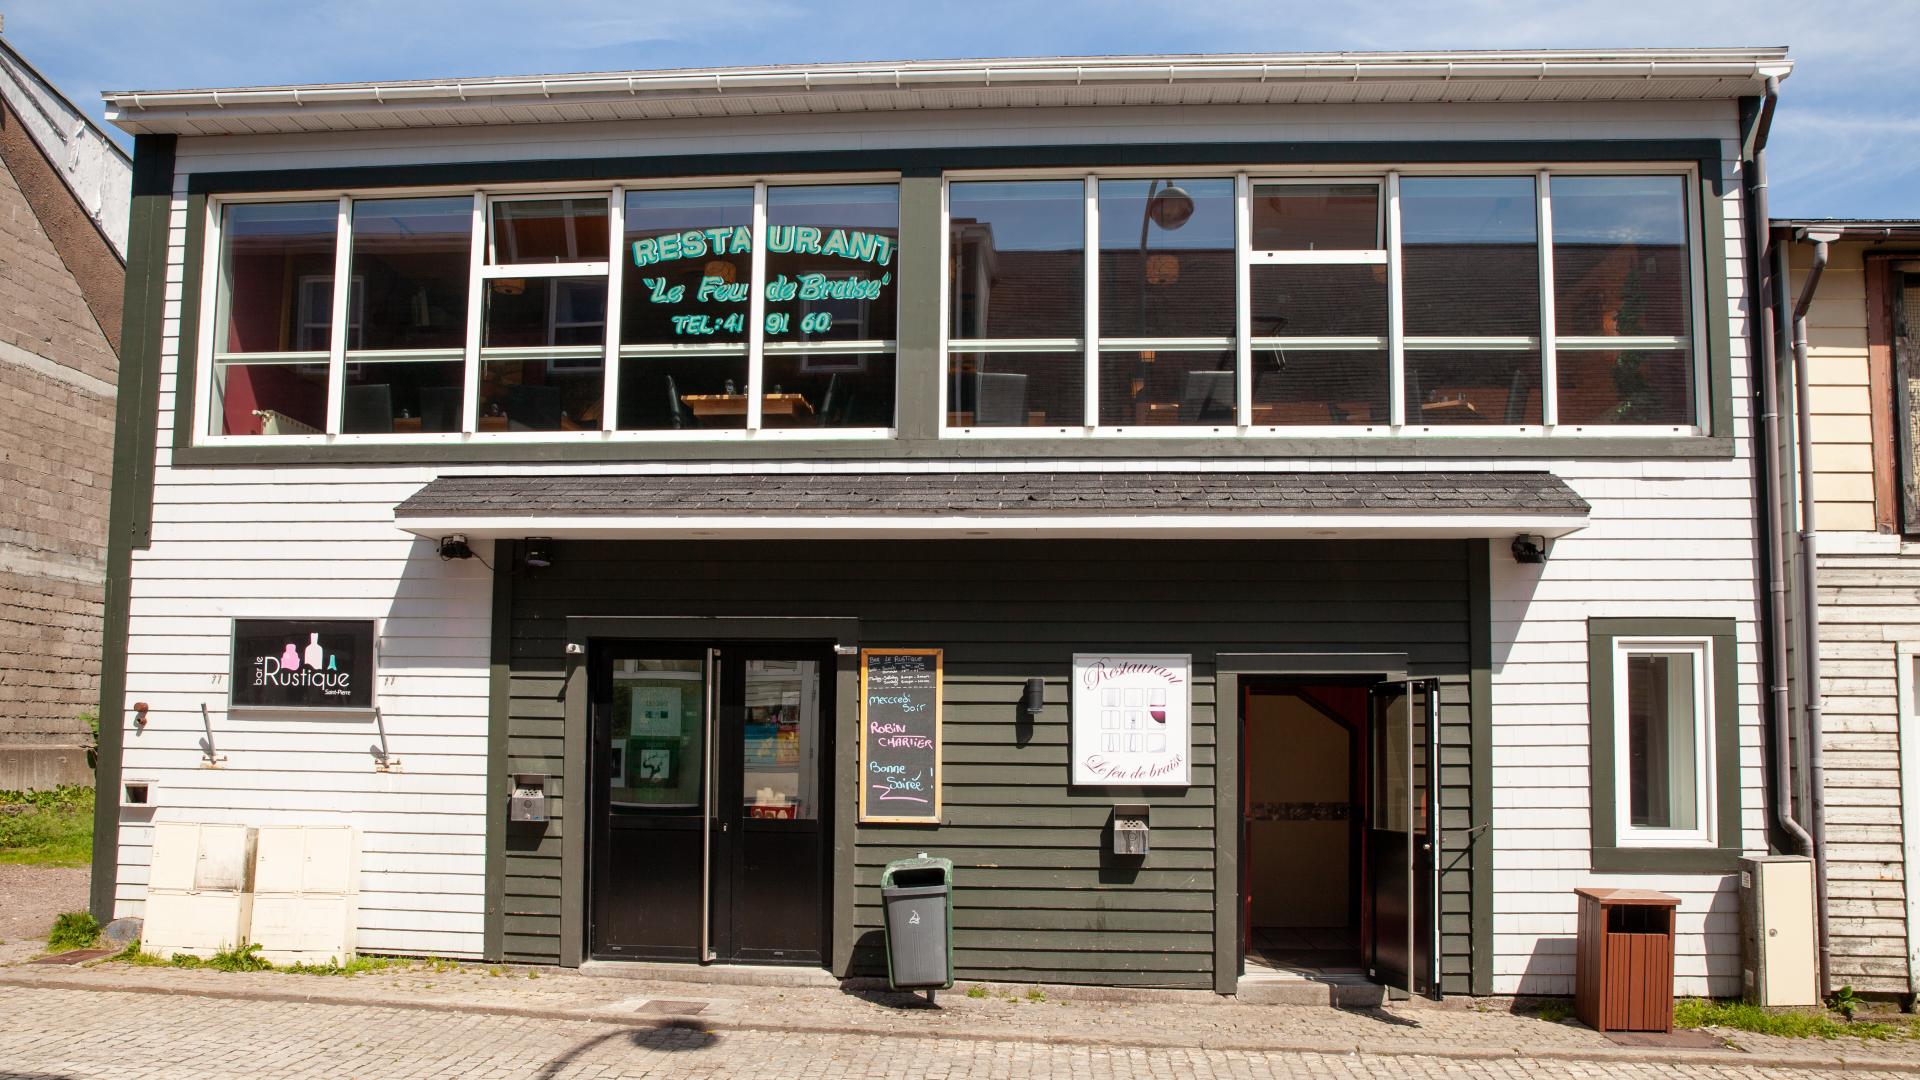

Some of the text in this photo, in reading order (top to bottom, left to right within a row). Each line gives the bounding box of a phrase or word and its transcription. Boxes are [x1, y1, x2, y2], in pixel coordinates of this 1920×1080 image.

[697, 275, 750, 302] Feu
[765, 273, 798, 302] de
[765, 312, 790, 335] 91
[800, 311, 833, 334] 60
[253, 656, 264, 686] bar le
[264, 656, 350, 691] Rustique
[1083, 656, 1184, 692] Restaurant
[324, 688, 351, 696] Saint-Pierre
[869, 760, 907, 775] Bonne
[1081, 753, 1183, 780] Le feu de braise
